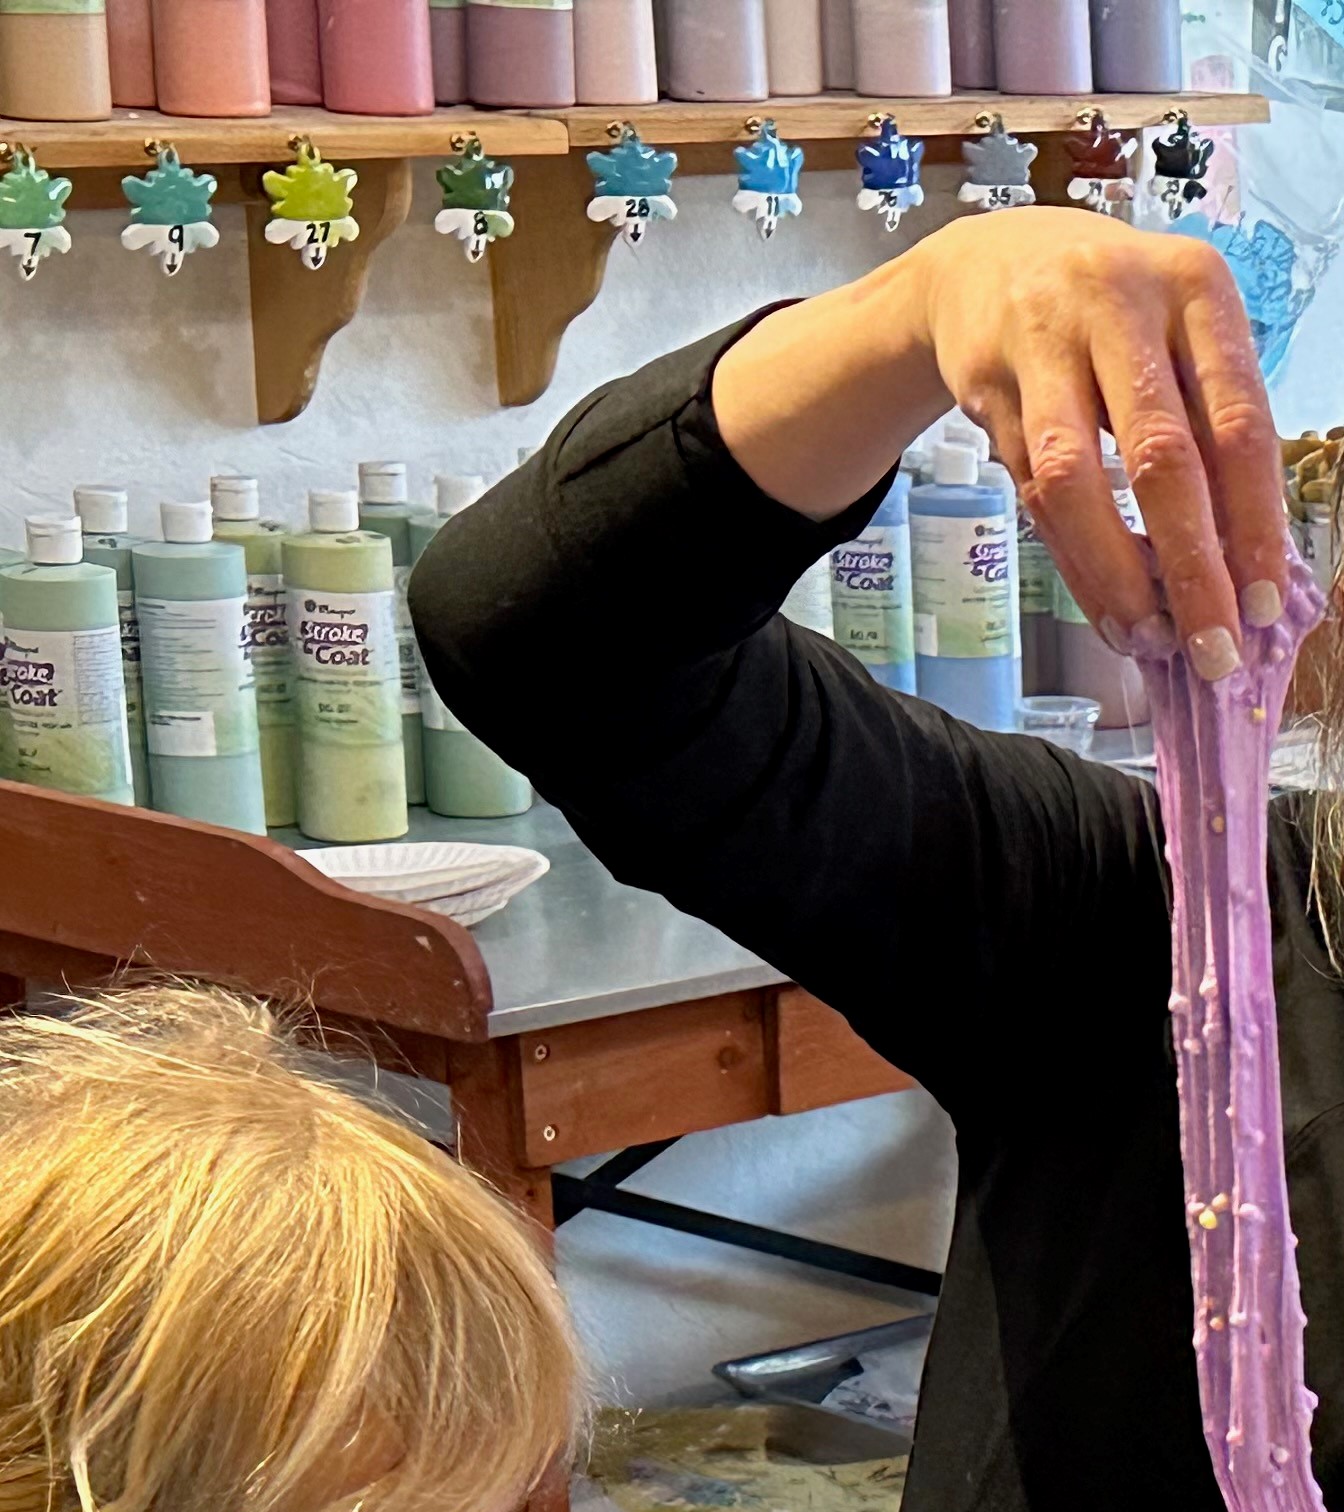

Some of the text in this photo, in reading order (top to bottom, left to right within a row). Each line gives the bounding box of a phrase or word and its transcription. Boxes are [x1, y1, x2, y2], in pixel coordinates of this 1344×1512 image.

[625, 197, 651, 220] 28
[306, 222, 332, 246] 27
[473, 212, 488, 237] 8
[24, 231, 42, 254] 7
[167, 225, 186, 253] 9
[303, 621, 367, 645] Stroke
[315, 645, 374, 666] Coat
[10, 687, 63, 707] Coat
